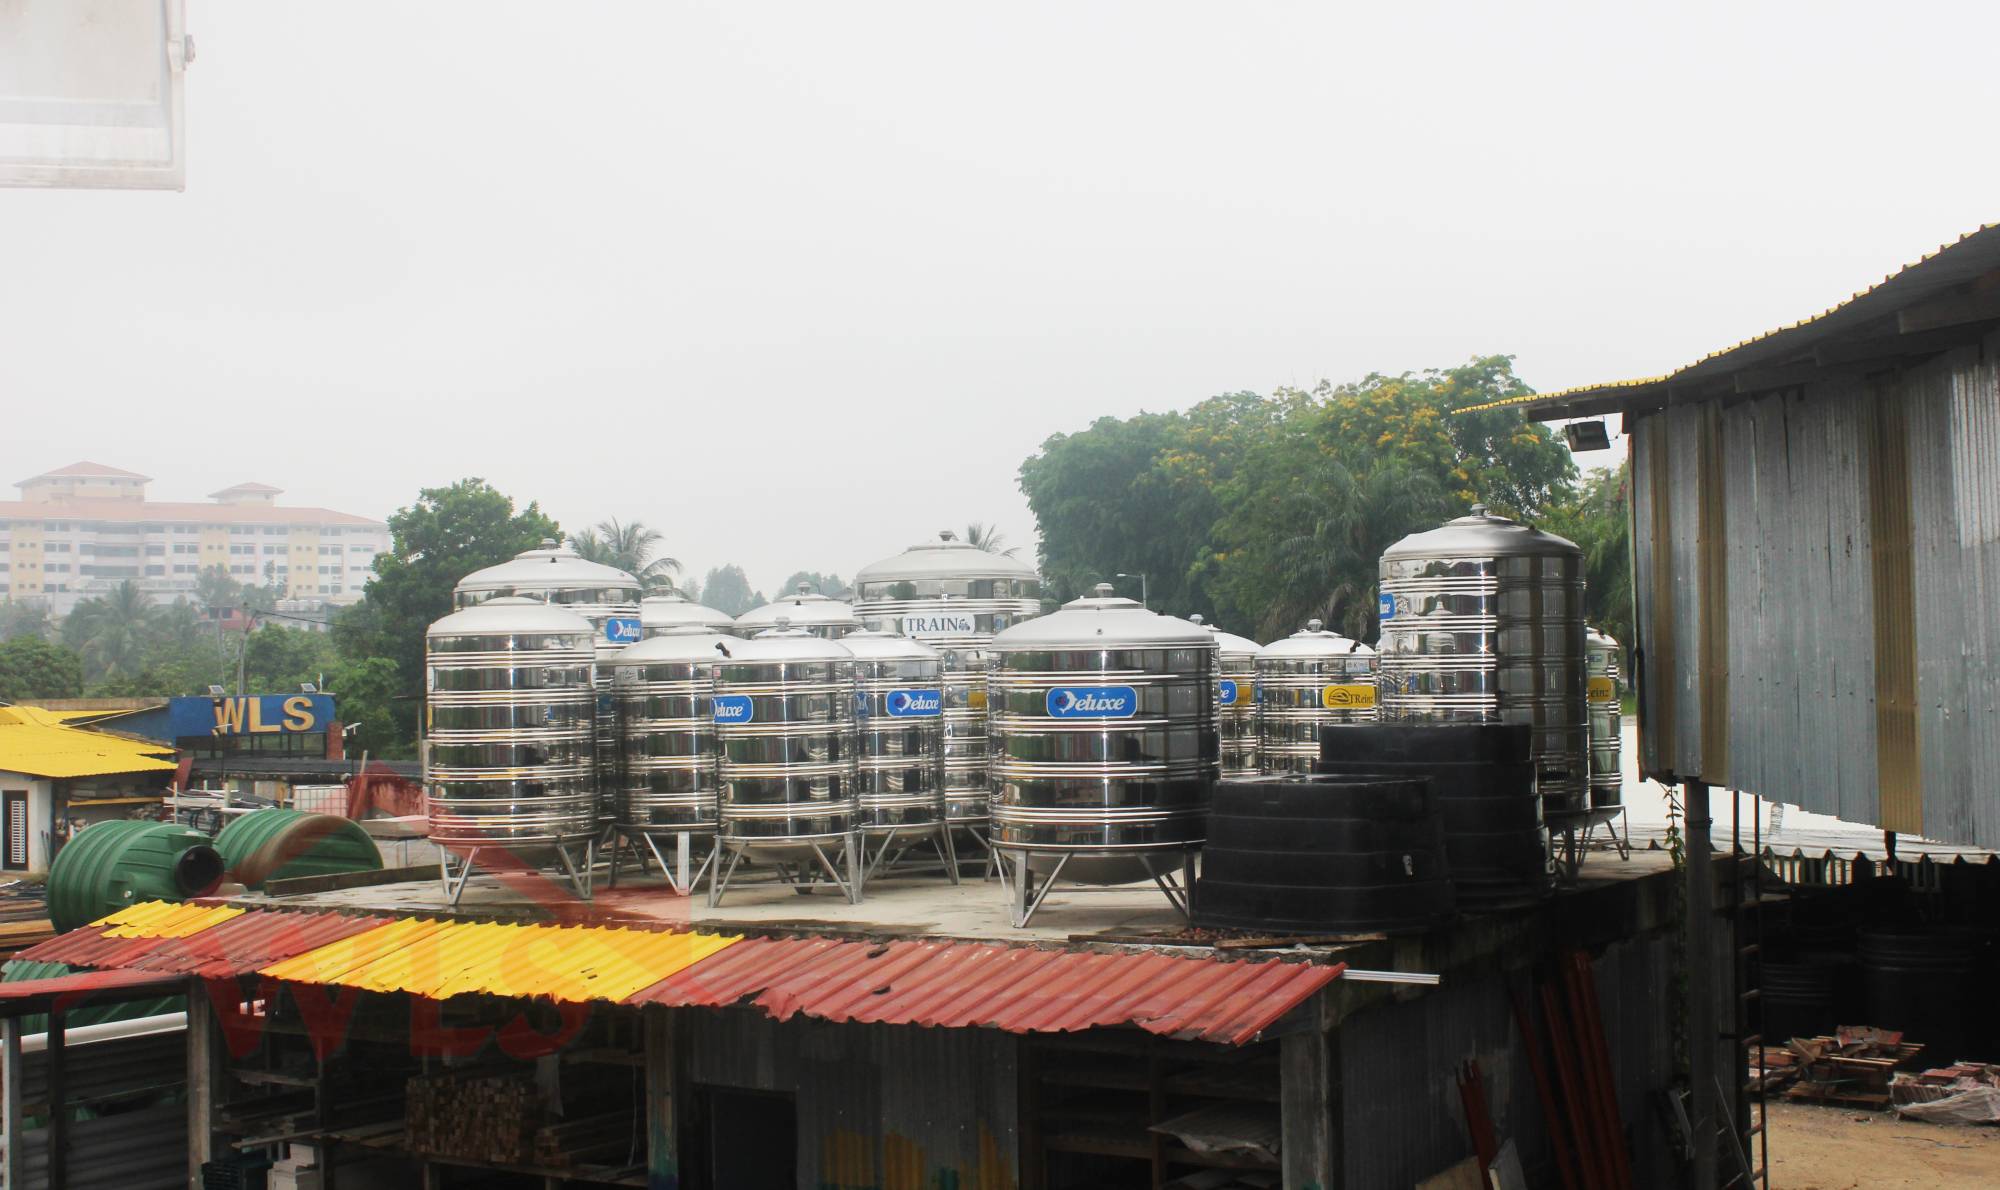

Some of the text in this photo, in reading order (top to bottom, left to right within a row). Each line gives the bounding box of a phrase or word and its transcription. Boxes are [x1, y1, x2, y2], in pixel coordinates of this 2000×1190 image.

[906, 617, 958, 633] TRAIN
[713, 698, 743, 720] eluxe
[894, 692, 940, 713] Deluxe
[1059, 691, 1125, 714] Deluxe
[213, 696, 315, 735] WLS
